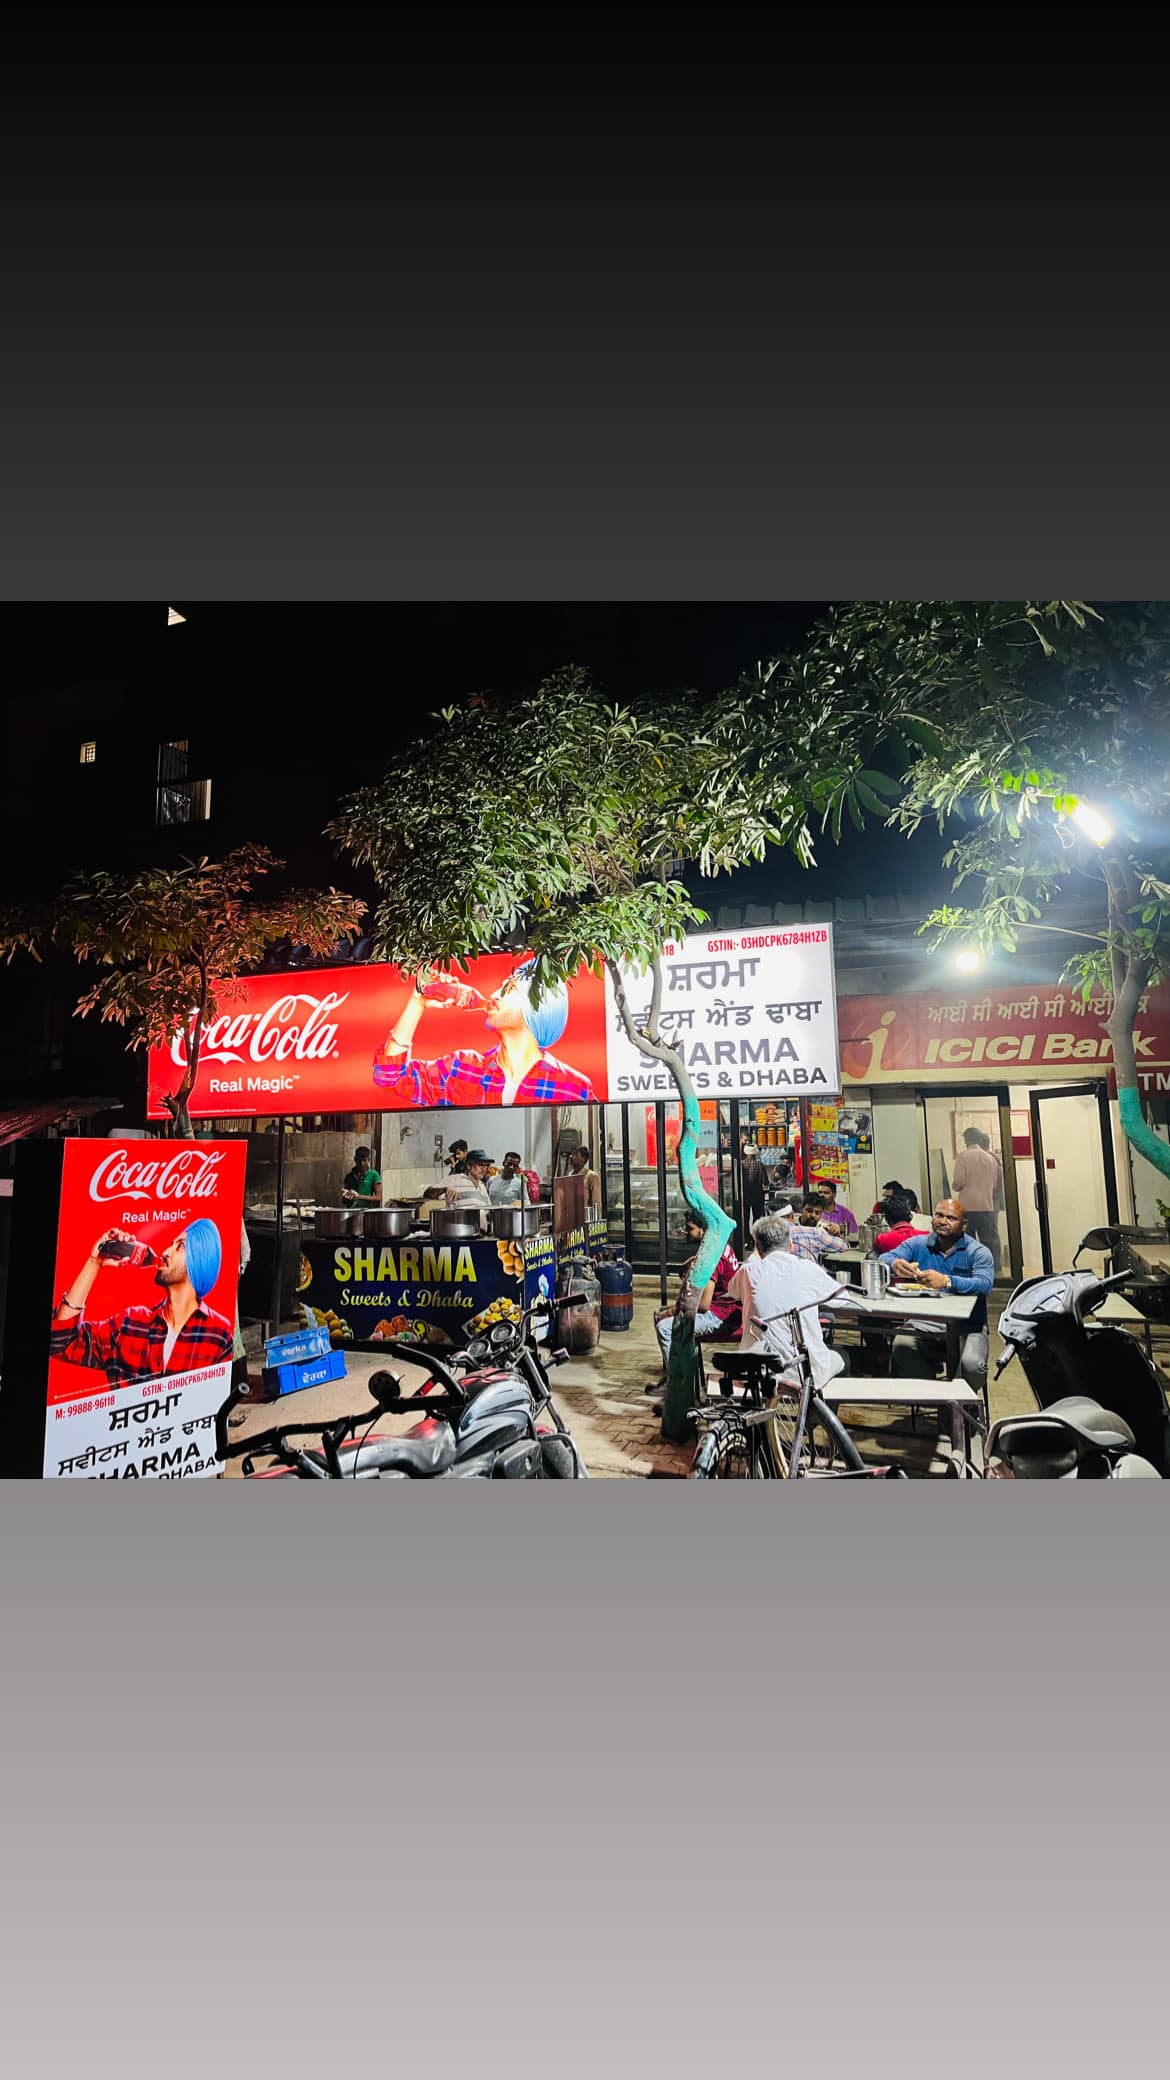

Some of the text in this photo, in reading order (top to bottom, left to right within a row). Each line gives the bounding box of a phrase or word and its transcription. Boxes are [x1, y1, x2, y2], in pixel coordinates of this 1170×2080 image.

[741, 930, 828, 950] 03HDCPK6784H1ZB
[667, 957, 761, 992] ਸ਼ਰਮਾ
[706, 998, 754, 1027] ਐਂਡ
[765, 1000, 823, 1025] ਢਾਬਾ
[928, 1000, 968, 1024] ਆਈ
[972, 998, 993, 1022] ਸੀ
[997, 995, 1040, 1021] ਆਈ
[1044, 993, 1066, 1019] ਸੀ
[924, 1033, 1036, 1064] ICICI
[210, 1079, 243, 1093] Real
[717, 1071, 732, 1087] &
[739, 1067, 828, 1087] DHABA
[1137, 1072, 1170, 1091] TM
[89, 1149, 227, 1203] Coca-Cola
[122, 1212, 149, 1224] Real
[525, 1237, 554, 1261] SHARMA
[334, 1246, 477, 1282] SHARMA
[340, 1288, 475, 1308] Sweets & Dhaba
[67, 1395, 116, 1417] 99888-96118
[108, 1393, 183, 1432] ਸ਼ਰਮਾ
[57, 1440, 130, 1476] ਸਵੀਟਸ
[137, 1426, 175, 1450] ਐਂਡ
[88, 1441, 201, 1479] HARMA
